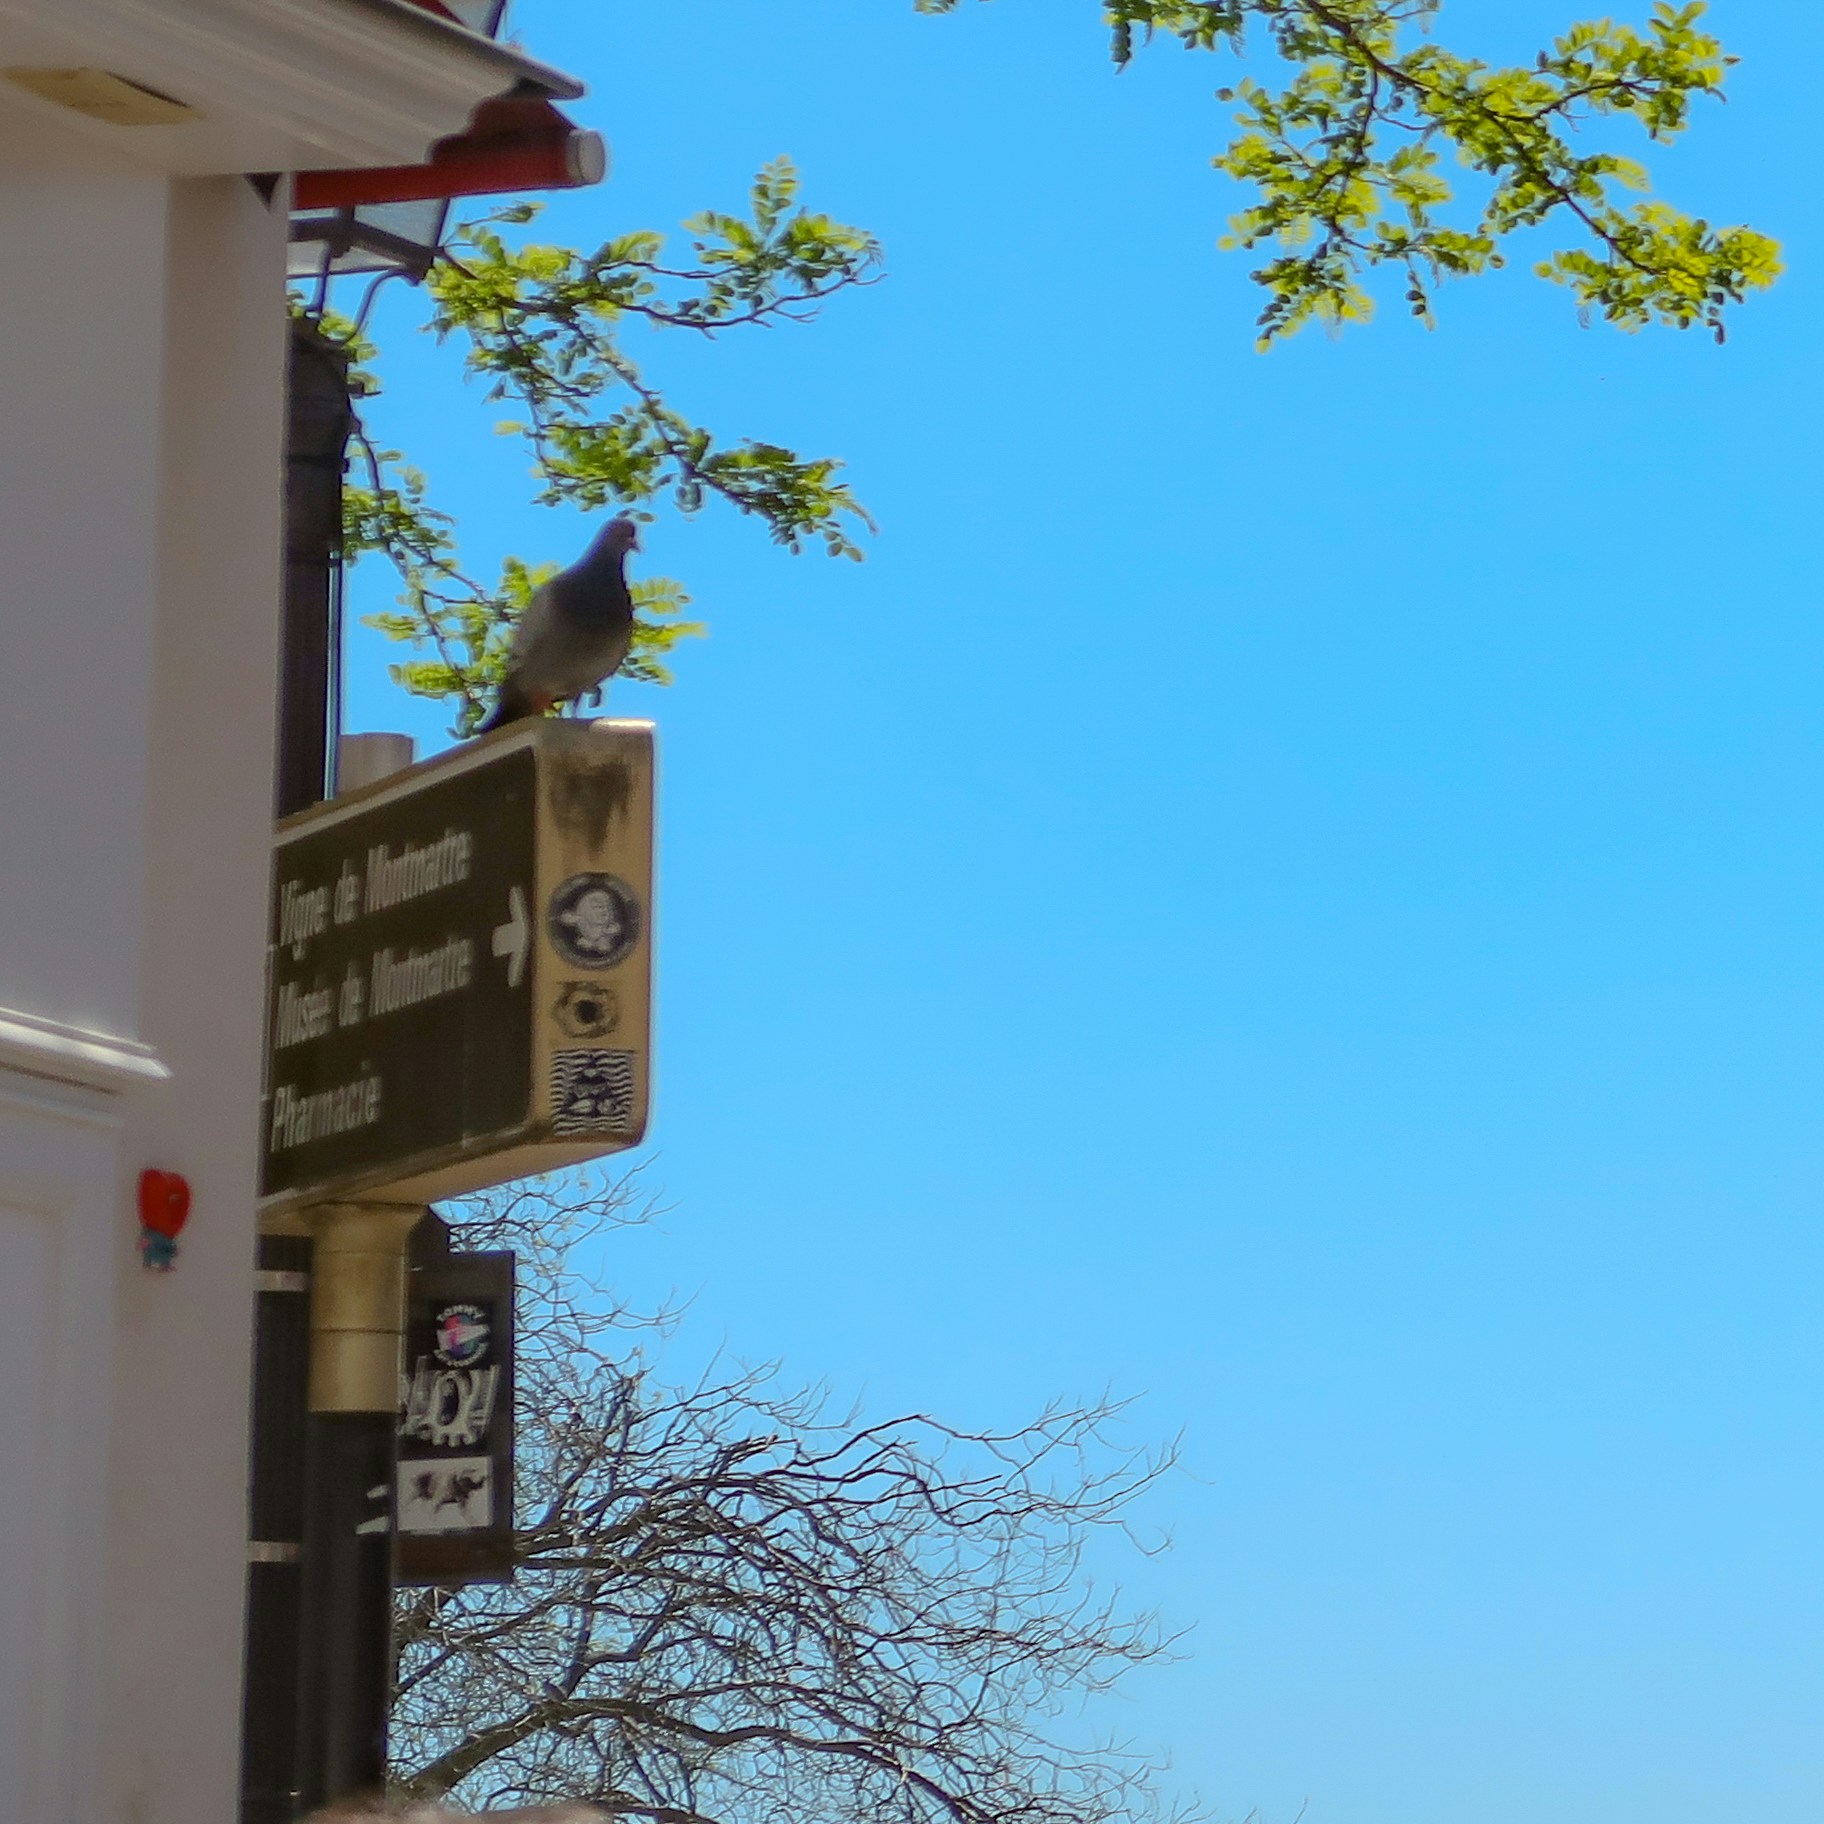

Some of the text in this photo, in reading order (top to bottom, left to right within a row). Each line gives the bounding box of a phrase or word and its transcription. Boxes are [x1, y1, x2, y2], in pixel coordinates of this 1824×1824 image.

[281, 829, 472, 960] Vigne de Montmartre
[339, 961, 364, 1027] de
[372, 935, 472, 1014] Montmartre
[273, 1060, 380, 1150] Pharmacie
